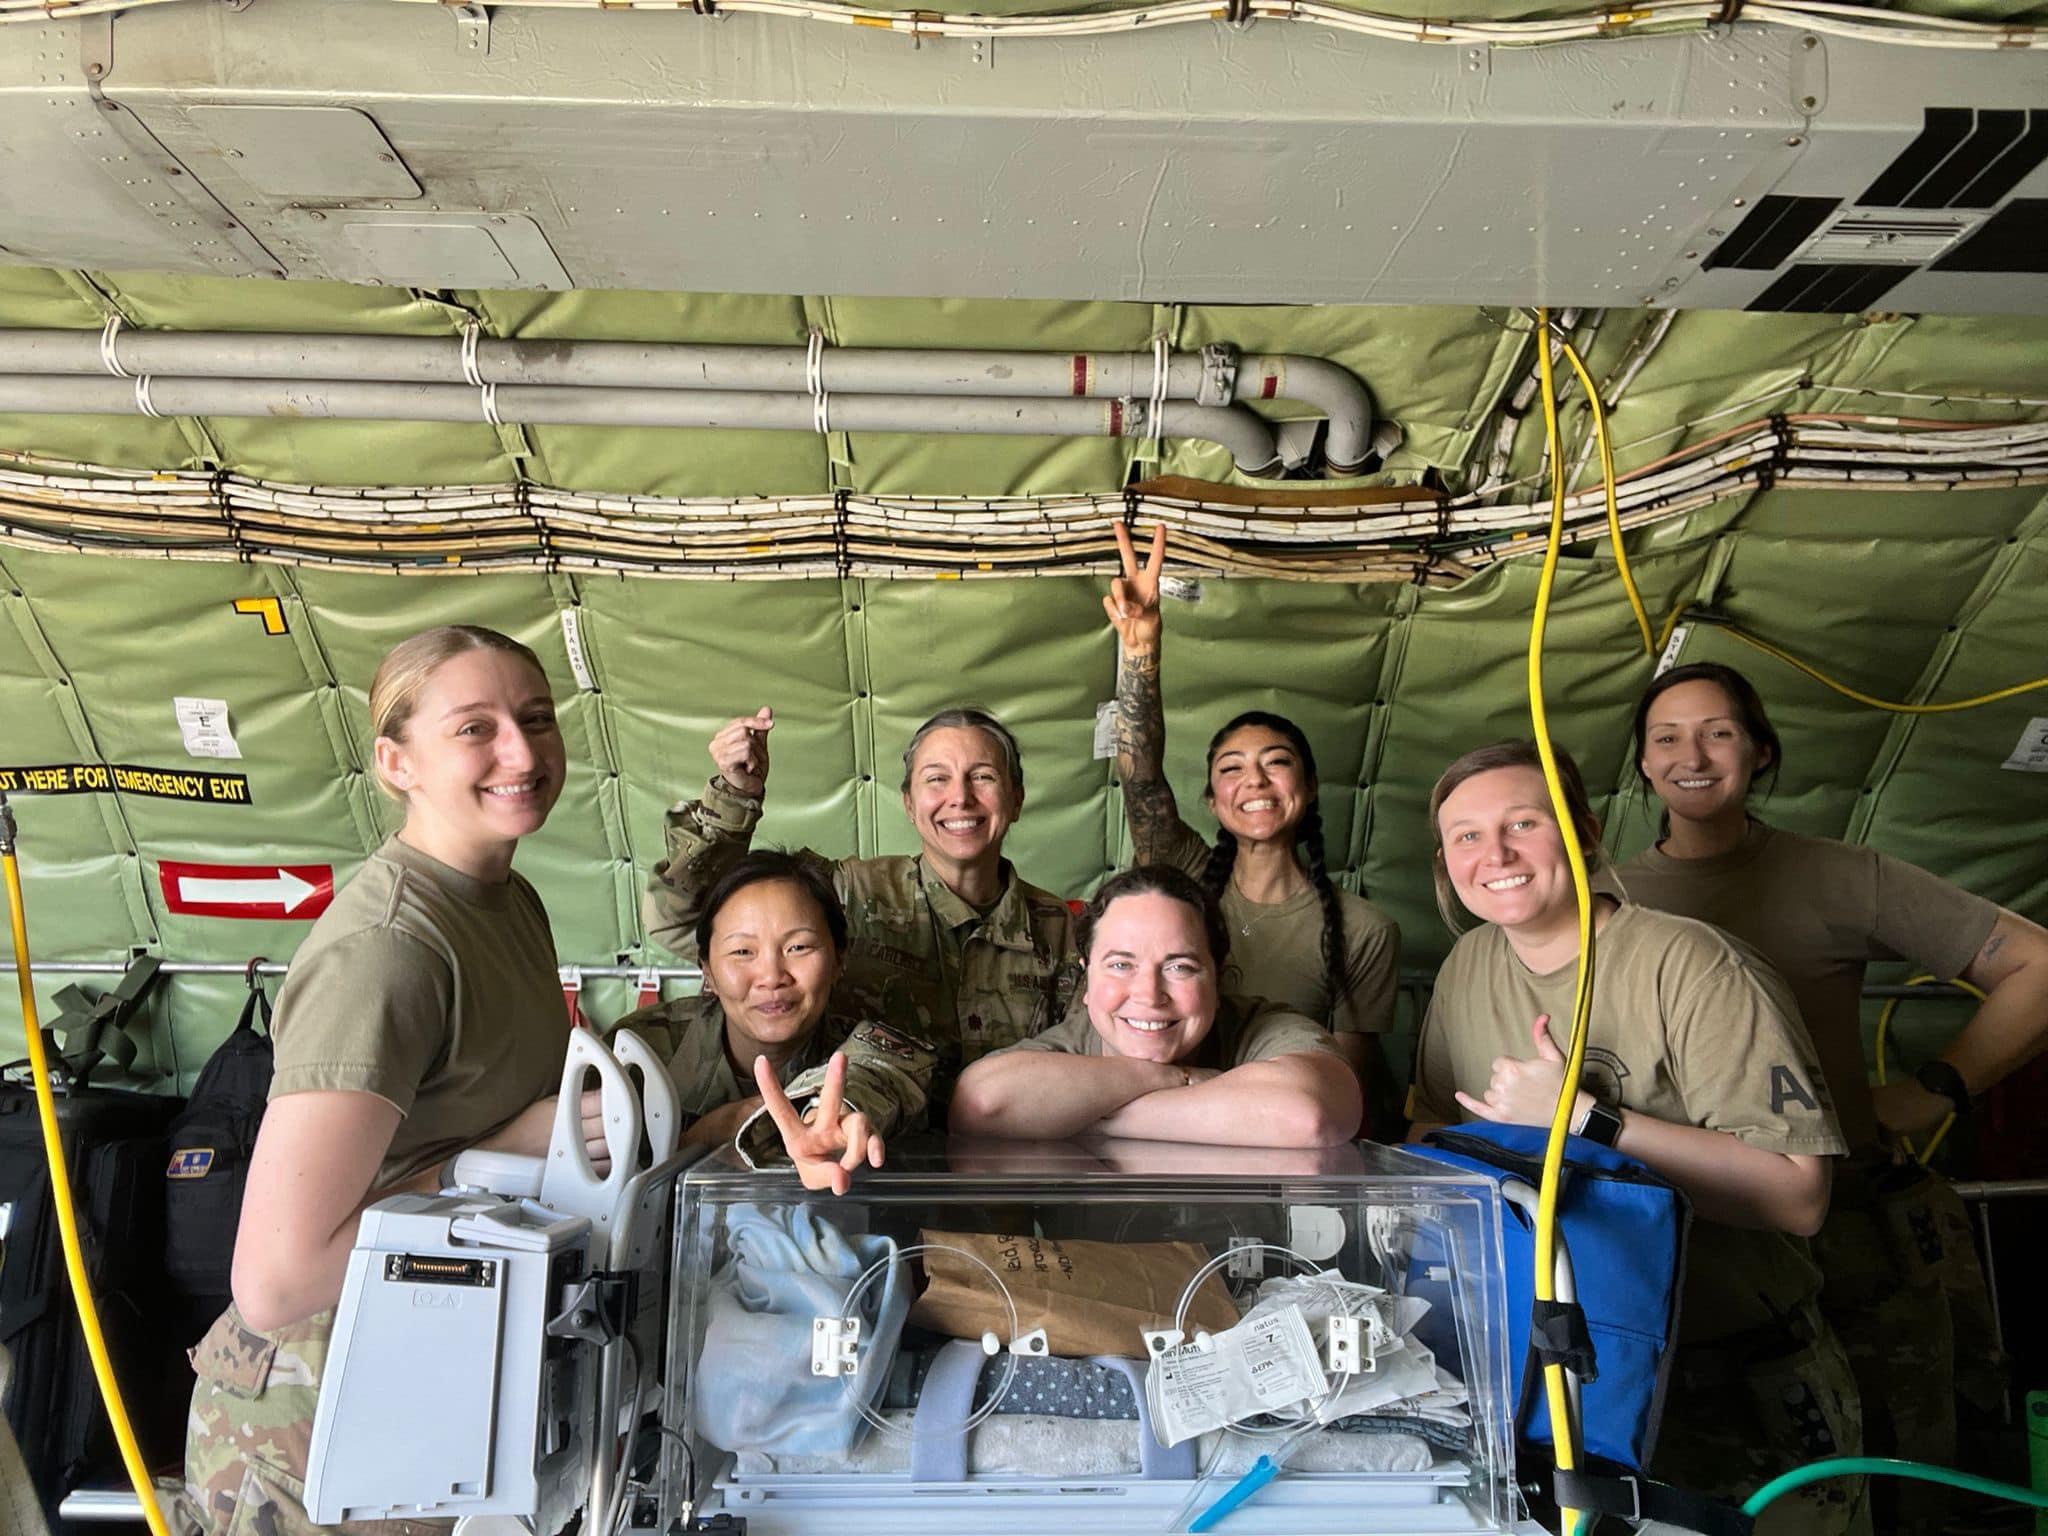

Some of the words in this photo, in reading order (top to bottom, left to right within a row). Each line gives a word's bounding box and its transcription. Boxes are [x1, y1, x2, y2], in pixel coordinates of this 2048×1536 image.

[21, 767, 69, 790] HERE
[73, 766, 110, 789] FOR
[114, 768, 205, 798] EMERGENCY
[210, 777, 245, 800] EXIT
[1265, 1333, 1274, 1344] 7
